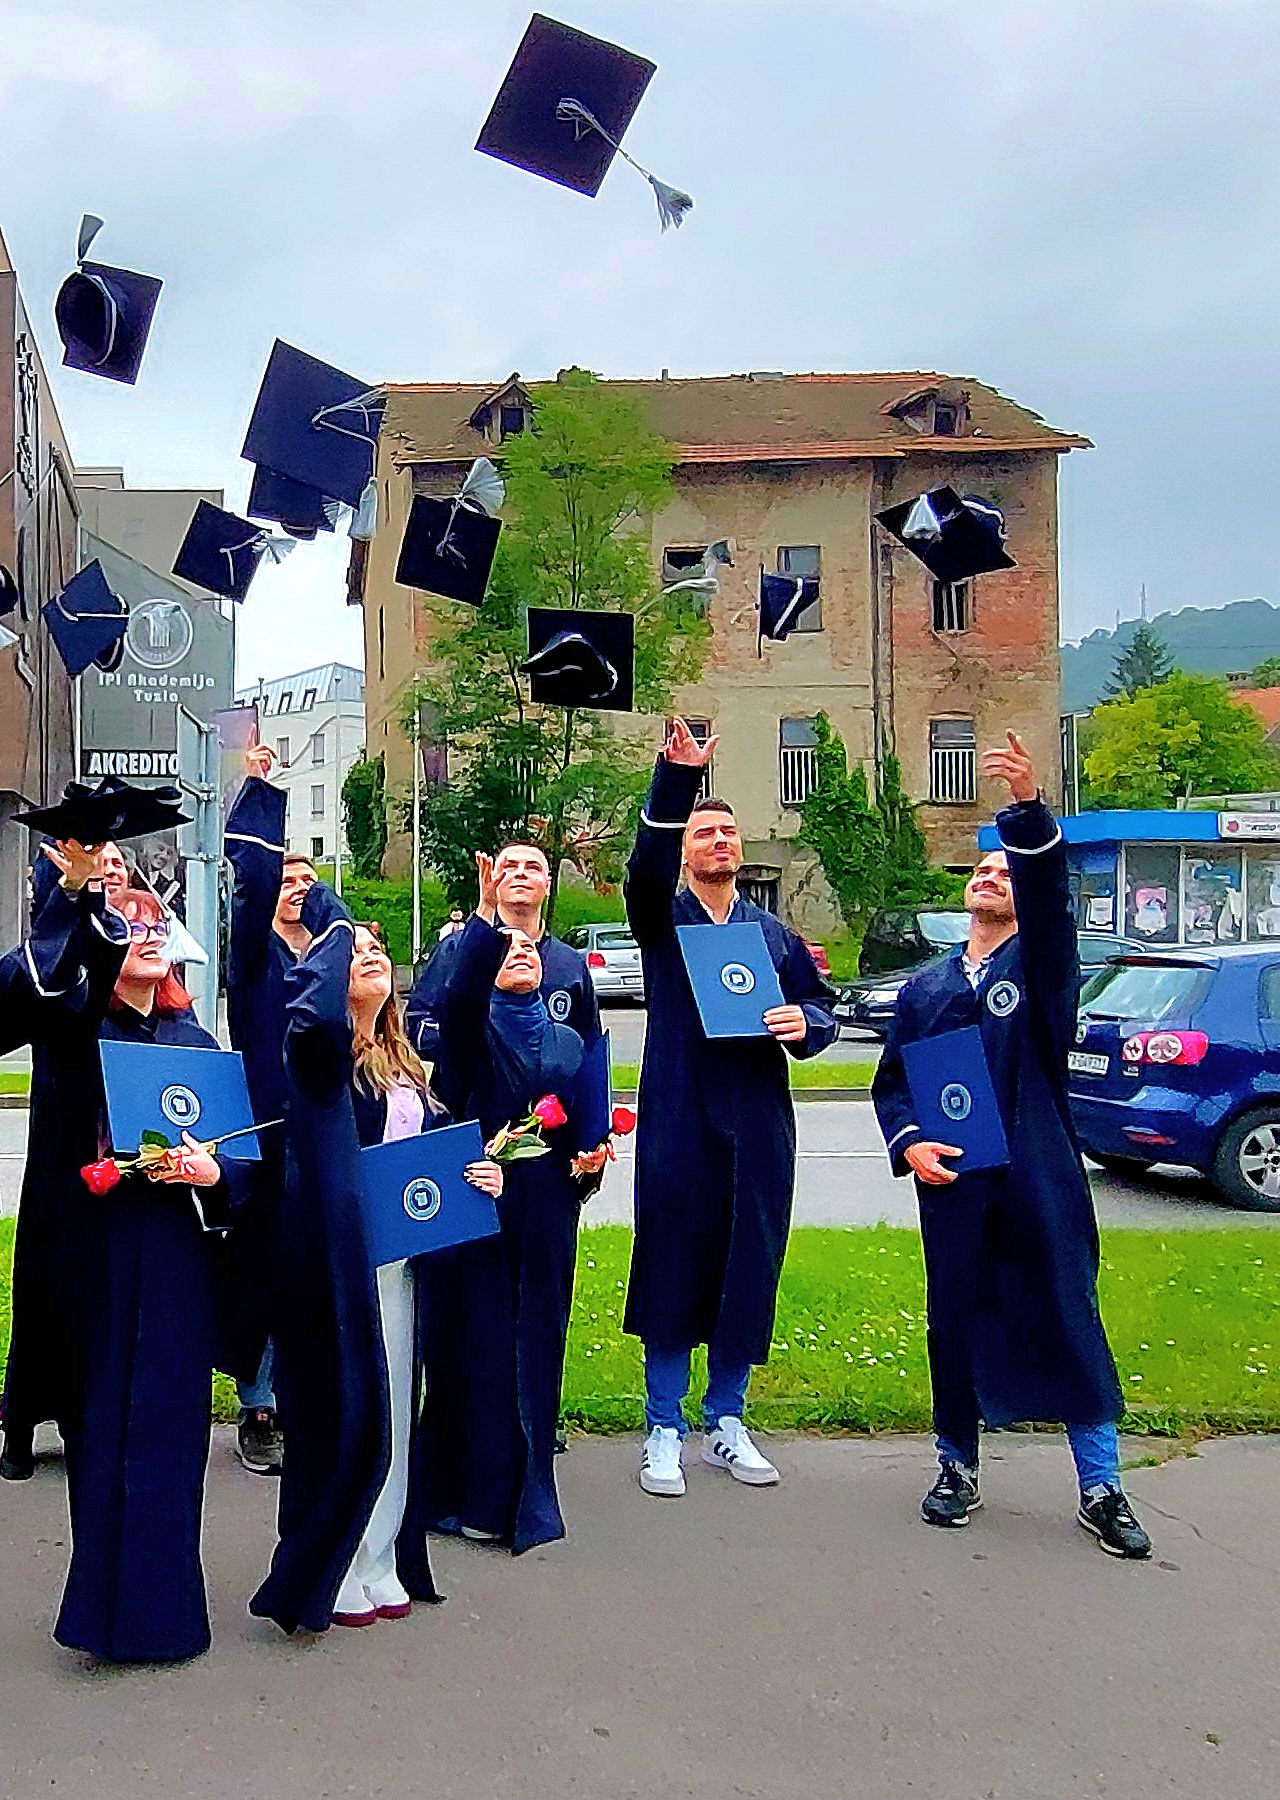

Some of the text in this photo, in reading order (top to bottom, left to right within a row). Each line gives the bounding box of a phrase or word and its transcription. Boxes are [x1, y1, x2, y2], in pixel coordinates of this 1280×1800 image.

[99, 673, 215, 690] IPI Akademija
[133, 689, 179, 702] Tuzla
